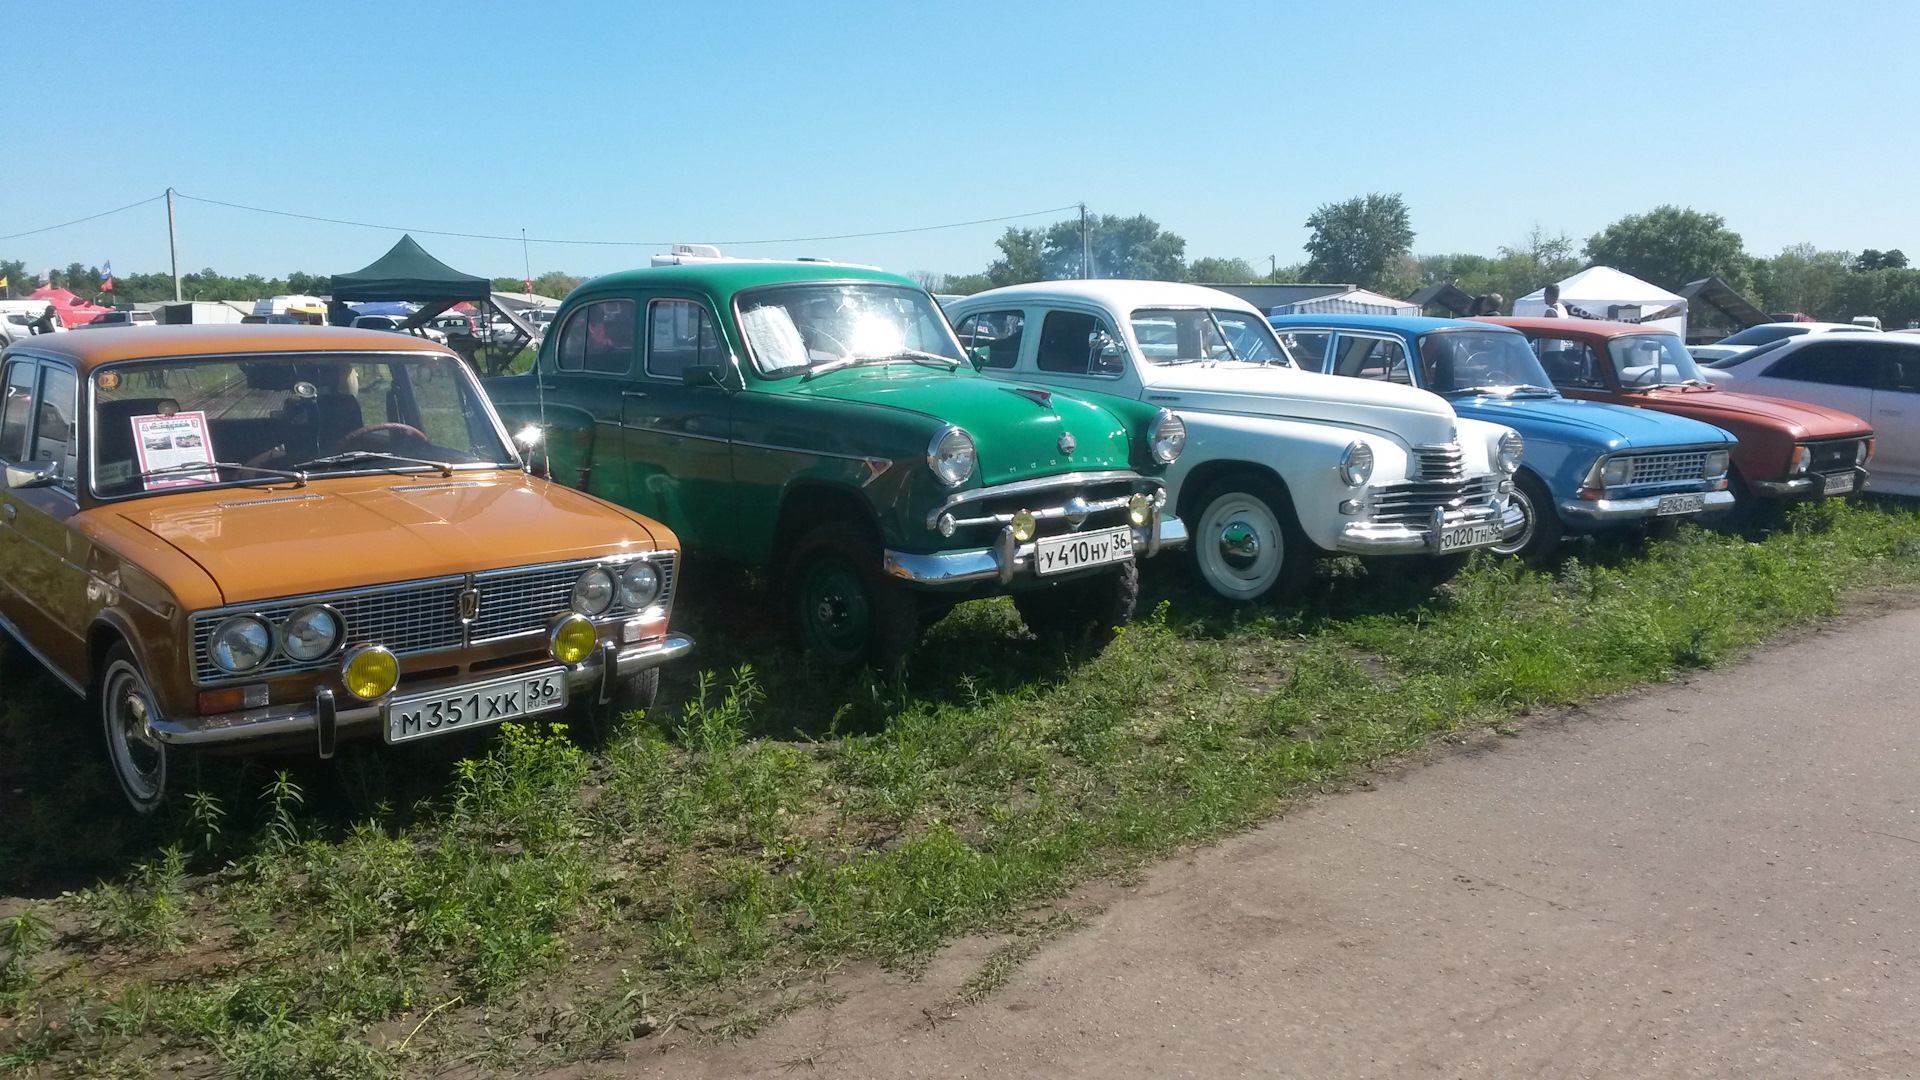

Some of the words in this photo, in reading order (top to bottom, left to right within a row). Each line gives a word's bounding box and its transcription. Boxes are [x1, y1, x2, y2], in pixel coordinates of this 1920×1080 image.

[1045, 541, 1109, 568] У410НУ
[1112, 532, 1127, 550] 36
[1444, 527, 1487, 548] О020ТН
[1489, 523, 1500, 536] 36
[401, 690, 520, 734] М351ХК
[528, 676, 555, 700] 36
[527, 698, 548, 709] RUS
